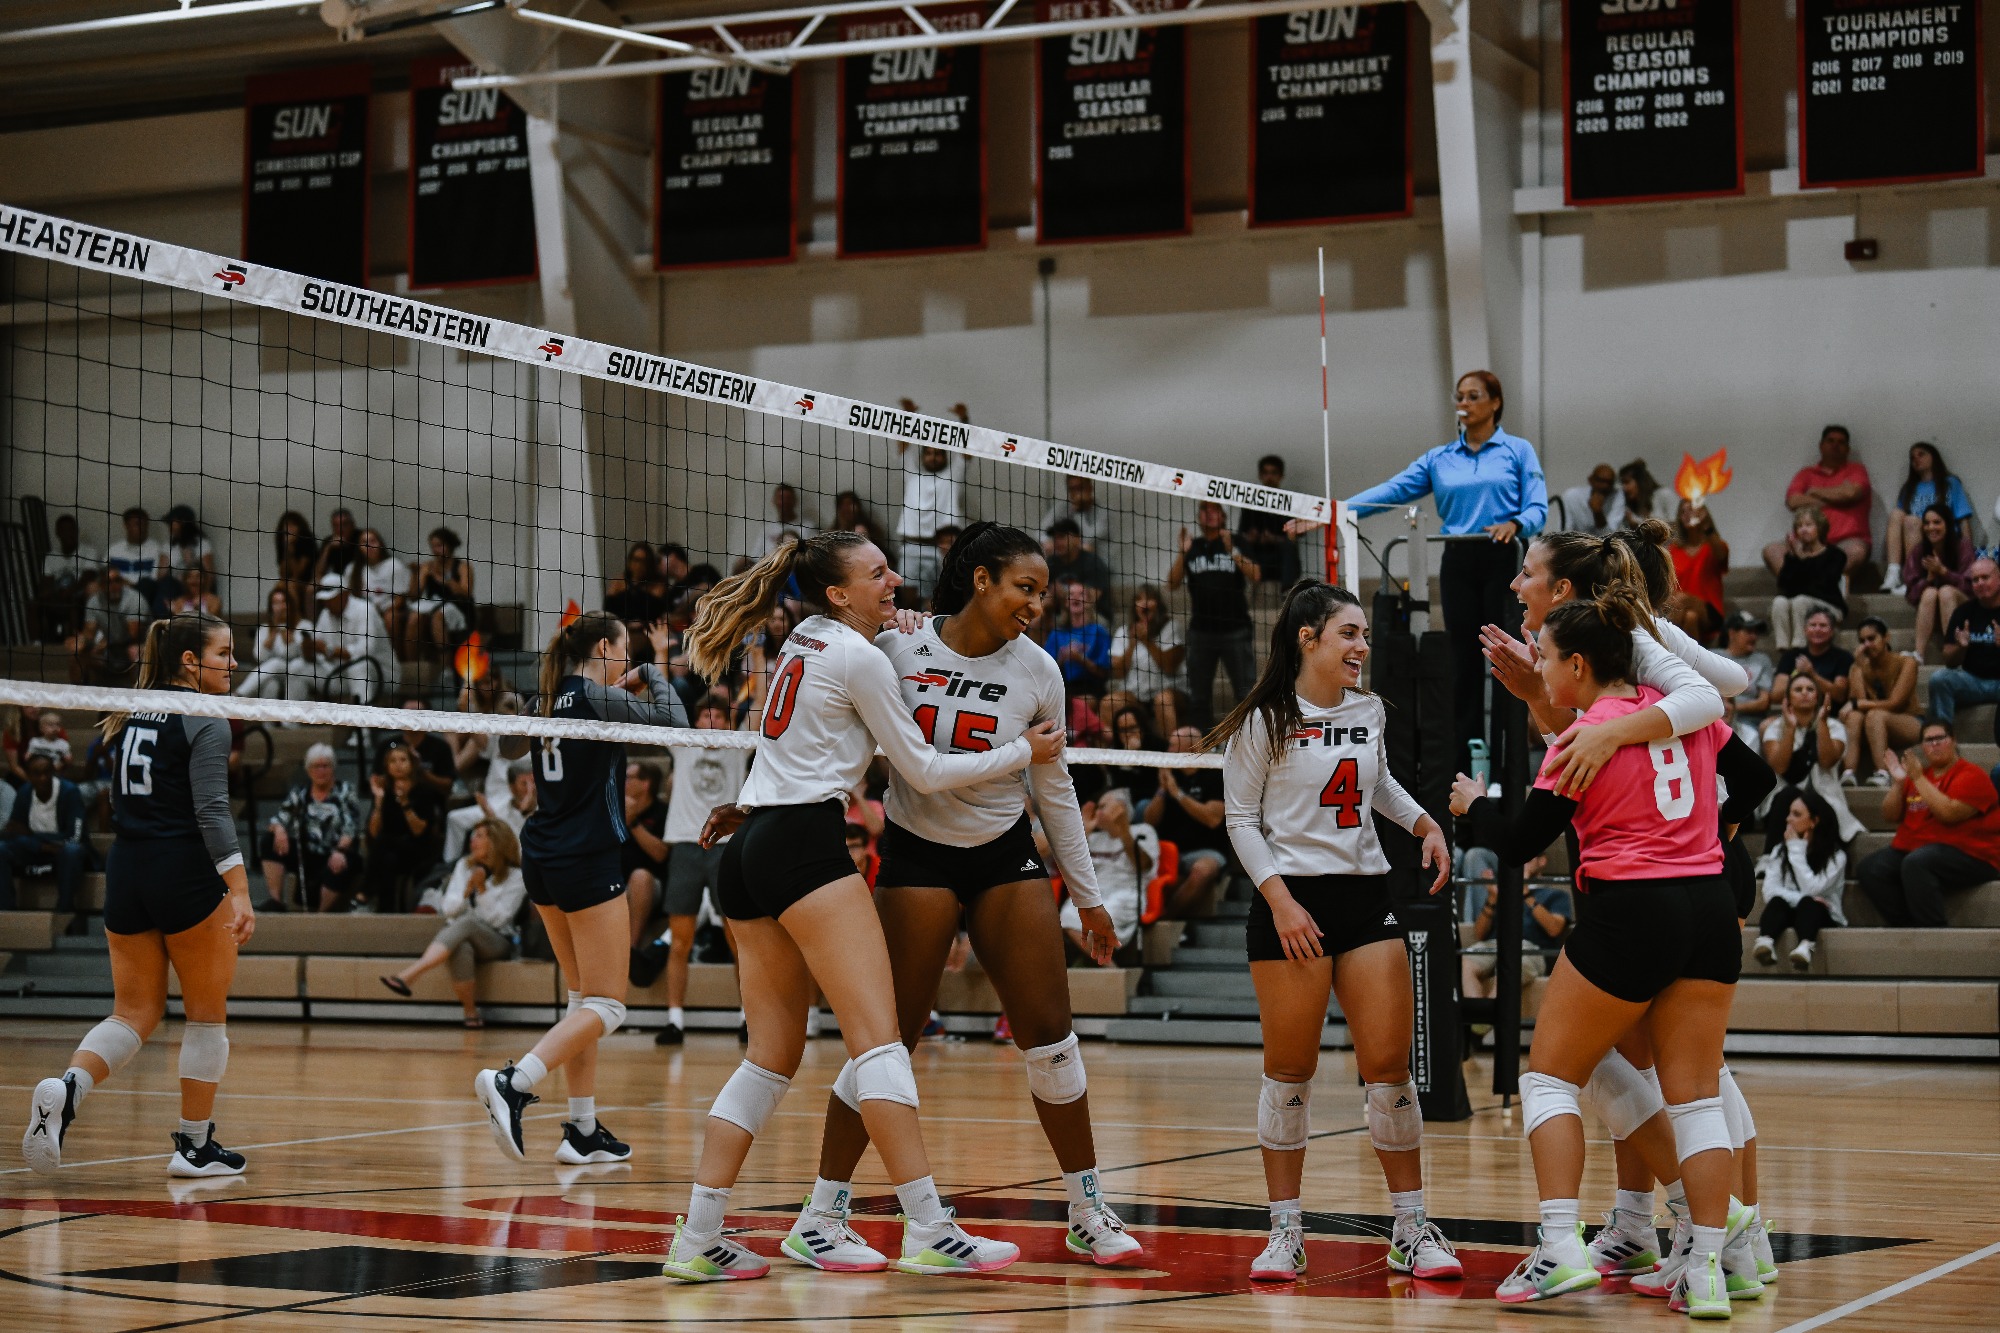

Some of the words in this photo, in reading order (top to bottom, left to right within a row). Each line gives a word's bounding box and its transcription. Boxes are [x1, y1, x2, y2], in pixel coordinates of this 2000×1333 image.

[1283, 6, 1360, 45] SUN
[1822, 4, 1961, 34] TOURNAMENT
[1067, 29, 1139, 66] SUN
[1605, 28, 1695, 54] REGULAR
[1829, 25, 1950, 52] CHAMPIONS
[869, 47, 938, 85] SUN
[1268, 55, 1392, 83] TOURNAMENT
[1612, 48, 1692, 72] SEASON
[1851, 55, 1883, 73] 2017
[687, 66, 752, 101] SUN
[1073, 79, 1152, 102] REGULAR
[1277, 75, 1384, 101] CHAMPIONS
[1593, 66, 1710, 92] CHAMPIONS
[1851, 75, 1887, 93] 2022
[437, 88, 499, 126] SUN
[855, 96, 969, 121] TOURNAMENT
[1078, 98, 1147, 119] SEASON
[272, 104, 331, 141] SUN
[691, 113, 764, 135] REGULAR
[864, 114, 960, 138] CHAMPIONS
[1063, 115, 1163, 139] CHAMPIONS
[431, 136, 519, 160] CHAMPIONS
[696, 132, 758, 152] SEASON
[680, 148, 773, 170] CHAMPIONS
[0, 211, 151, 272] HEASTERN
[301, 282, 490, 348] SOUTHEASTERN
[606, 351, 757, 404] SOUTHEASTERN
[848, 404, 970, 449] SOUTHEASTERN
[1046, 446, 1145, 484] SOUTHEASTERN
[1207, 479, 1293, 512] SOUTHEASTERN
[902, 668, 1008, 702] Fire
[1291, 721, 1369, 748] Fire
[121, 725, 158, 796] 15
[1648, 736, 1696, 821] 8
[1319, 758, 1363, 829] 4
